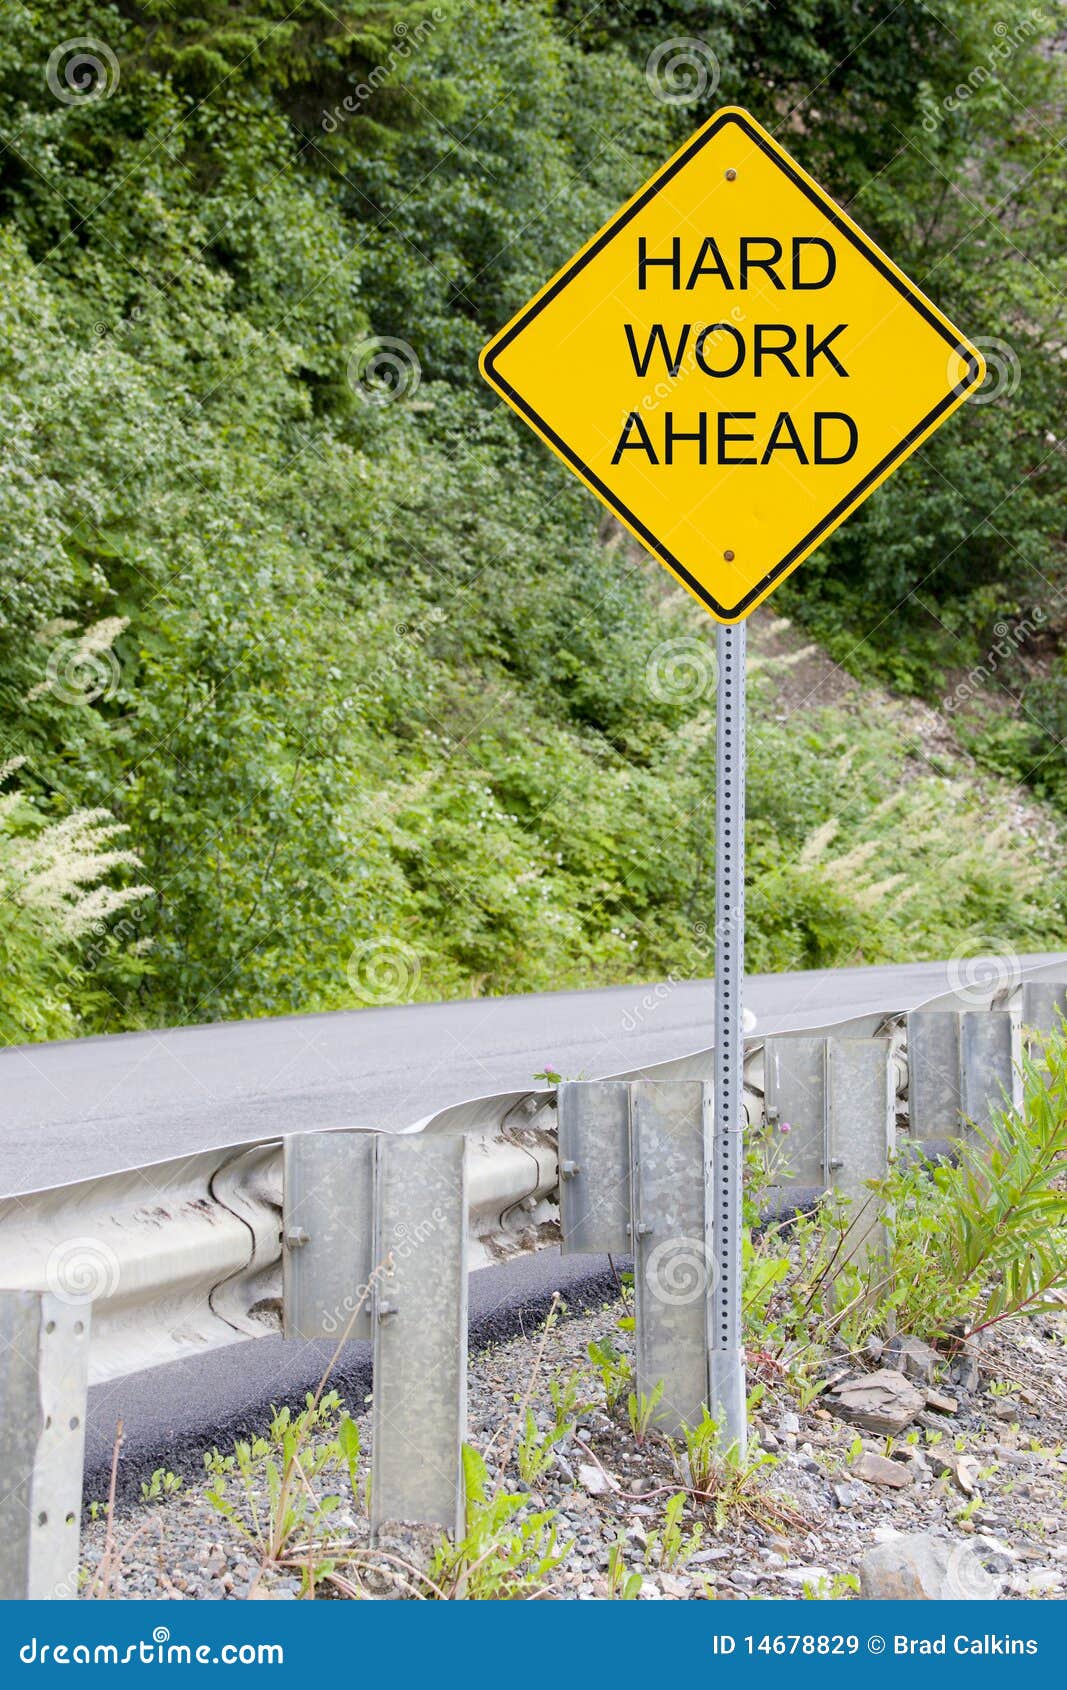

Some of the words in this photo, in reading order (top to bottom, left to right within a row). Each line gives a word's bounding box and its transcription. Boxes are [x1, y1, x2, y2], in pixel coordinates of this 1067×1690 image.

[638, 236, 837, 291] HARD
[623, 323, 850, 379] WORK
[610, 411, 859, 465] AHEAD
